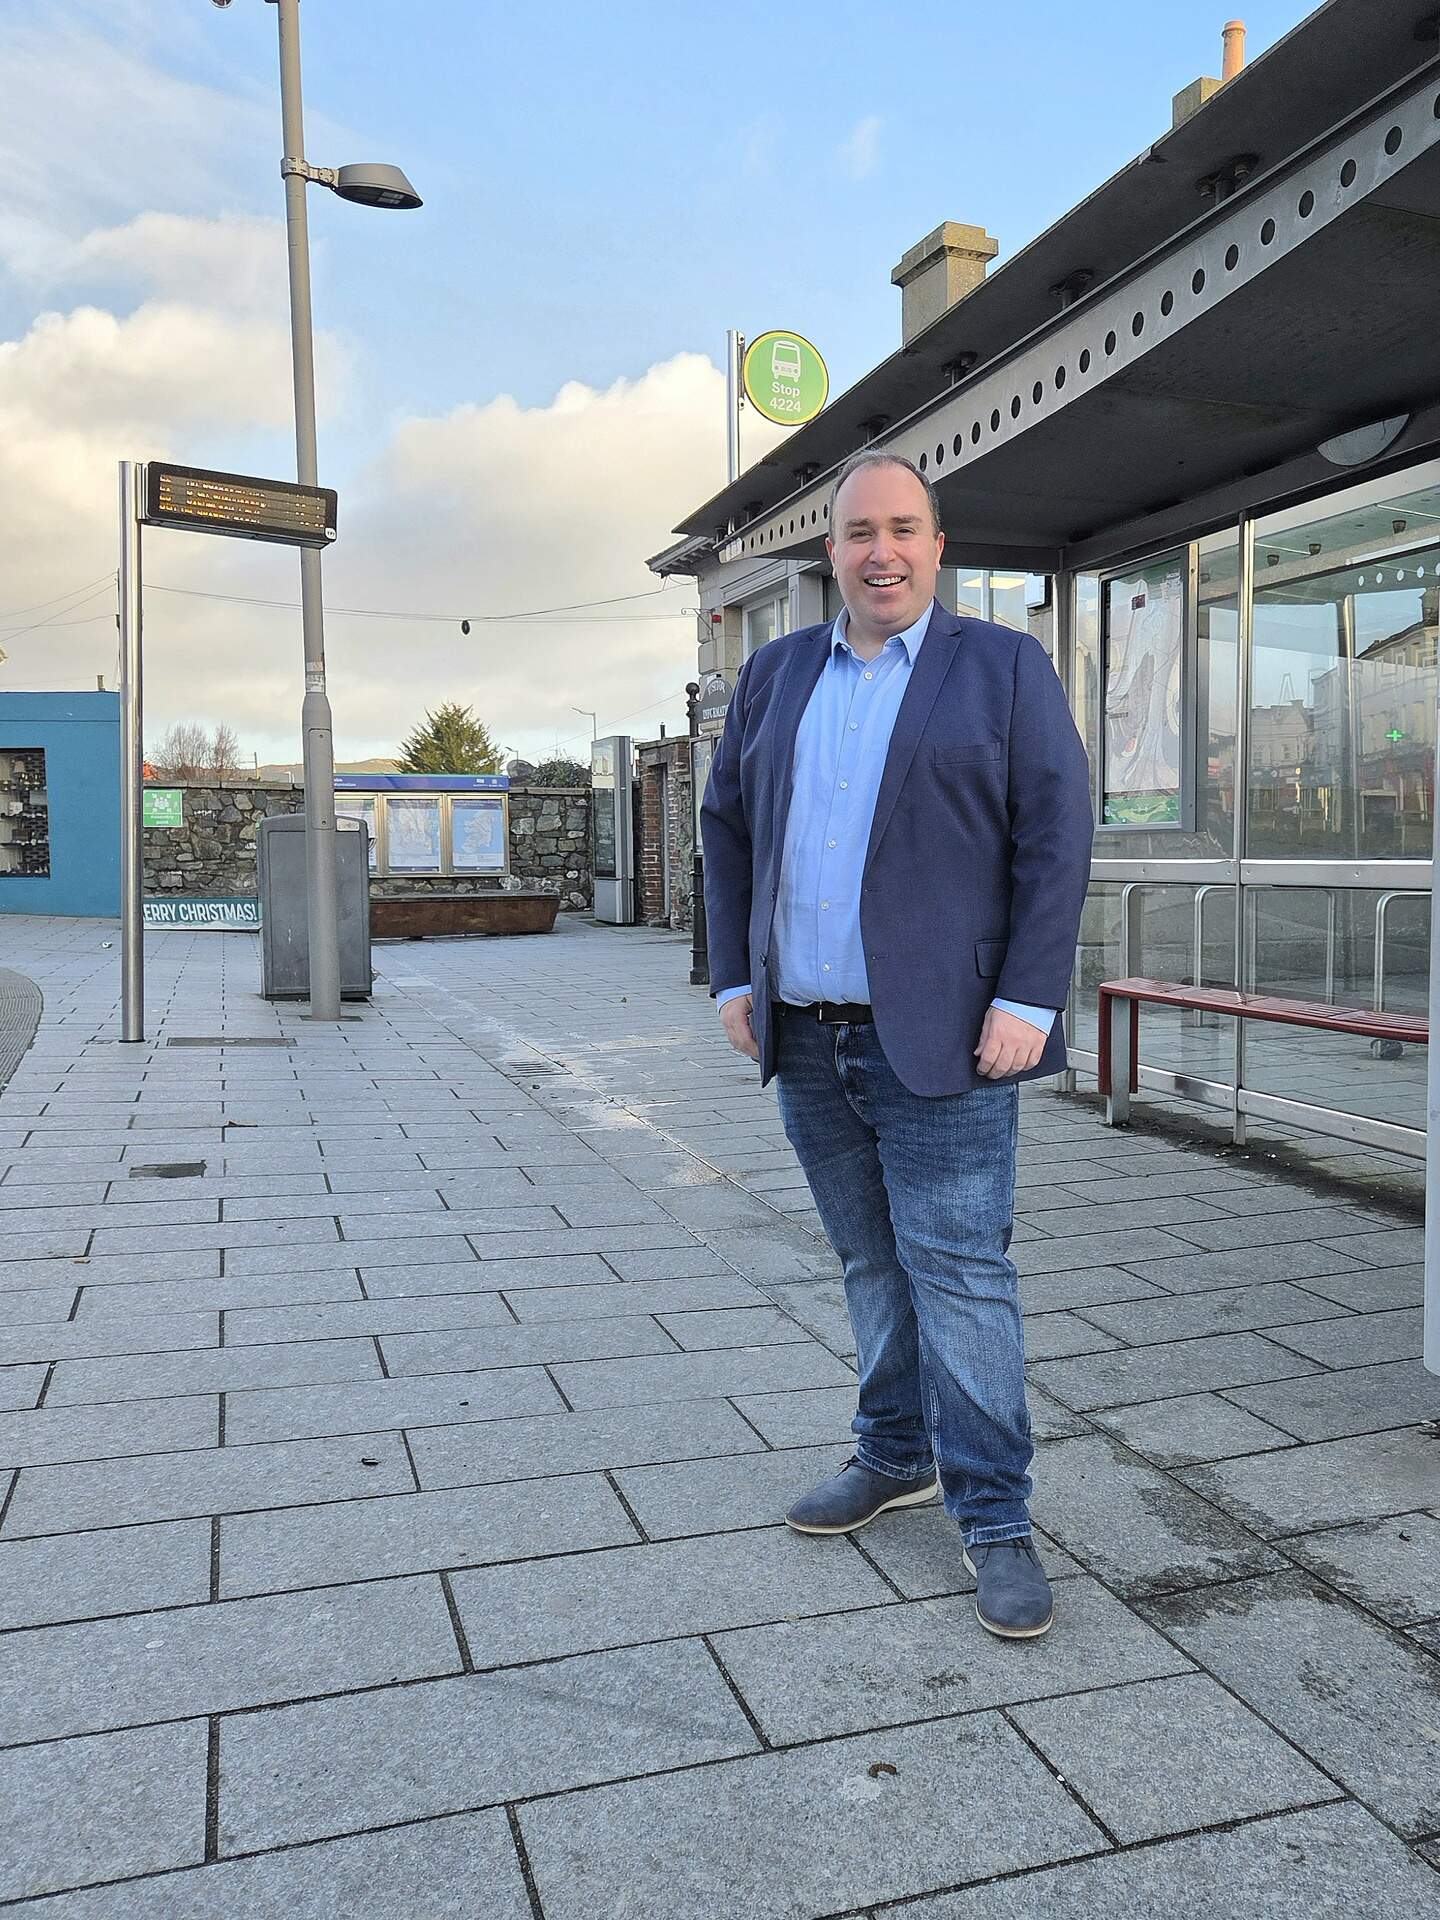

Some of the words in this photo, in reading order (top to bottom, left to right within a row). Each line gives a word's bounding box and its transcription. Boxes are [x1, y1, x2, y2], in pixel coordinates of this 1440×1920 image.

[771, 382, 800, 398] Stop
[769, 397, 802, 412] 4224
[143, 903, 176, 921] ERRY
[179, 903, 257, 921] CHRISTMAS!
